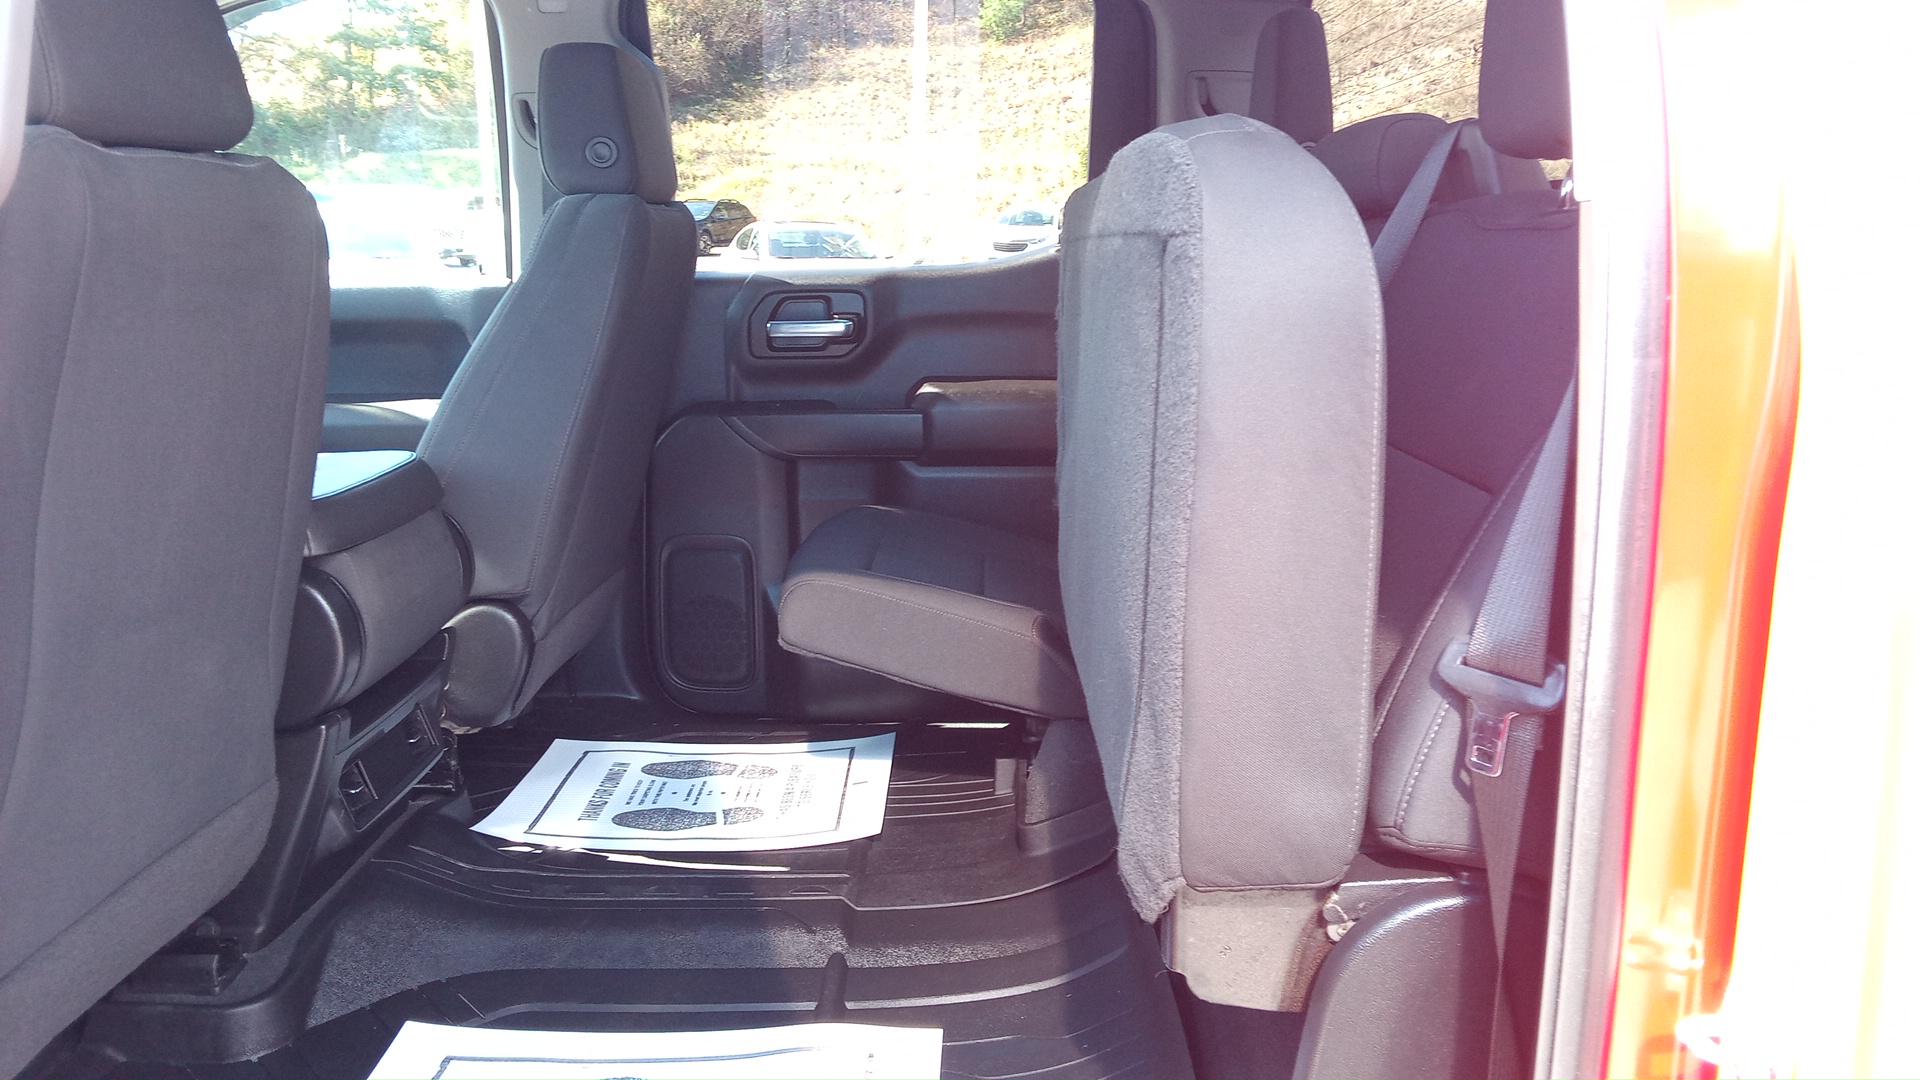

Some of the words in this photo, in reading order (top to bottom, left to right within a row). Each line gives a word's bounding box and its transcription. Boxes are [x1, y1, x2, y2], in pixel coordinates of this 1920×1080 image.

[598, 768, 628, 788] COMING
[591, 788, 616, 800] FOR
[577, 800, 609, 821] THANKS
